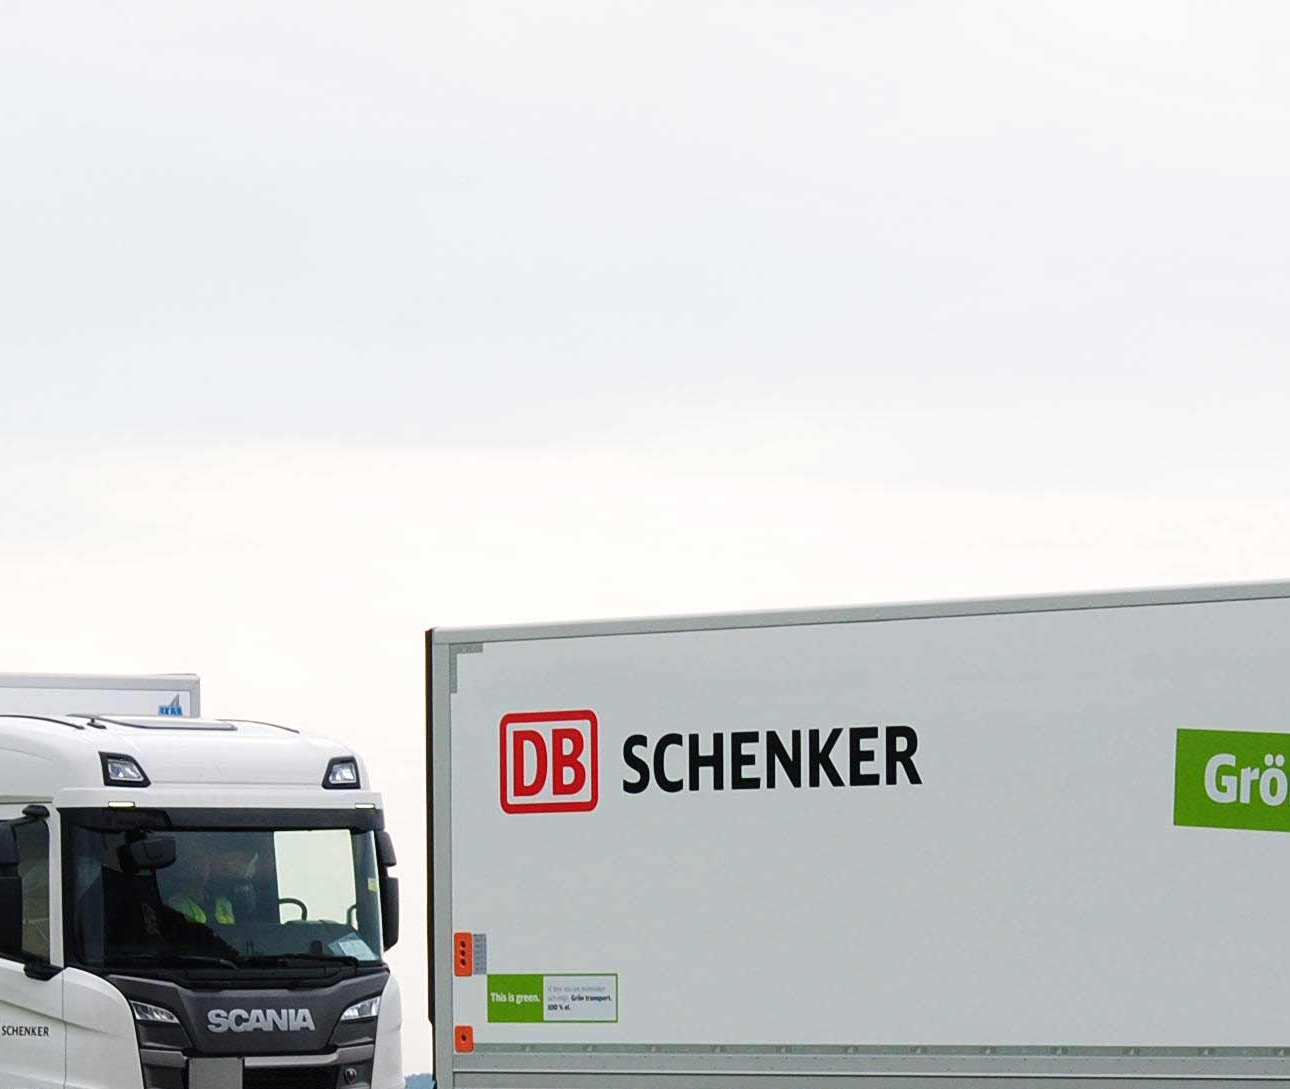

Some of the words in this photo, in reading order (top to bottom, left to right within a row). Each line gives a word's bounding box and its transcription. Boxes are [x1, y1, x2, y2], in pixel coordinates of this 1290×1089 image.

[512, 727, 587, 798] DB
[622, 725, 923, 794] SCHENKER
[490, 992, 506, 1003] This
[207, 1008, 316, 1033] SCANIA
[1, 1025, 50, 1037] SCHENKER
